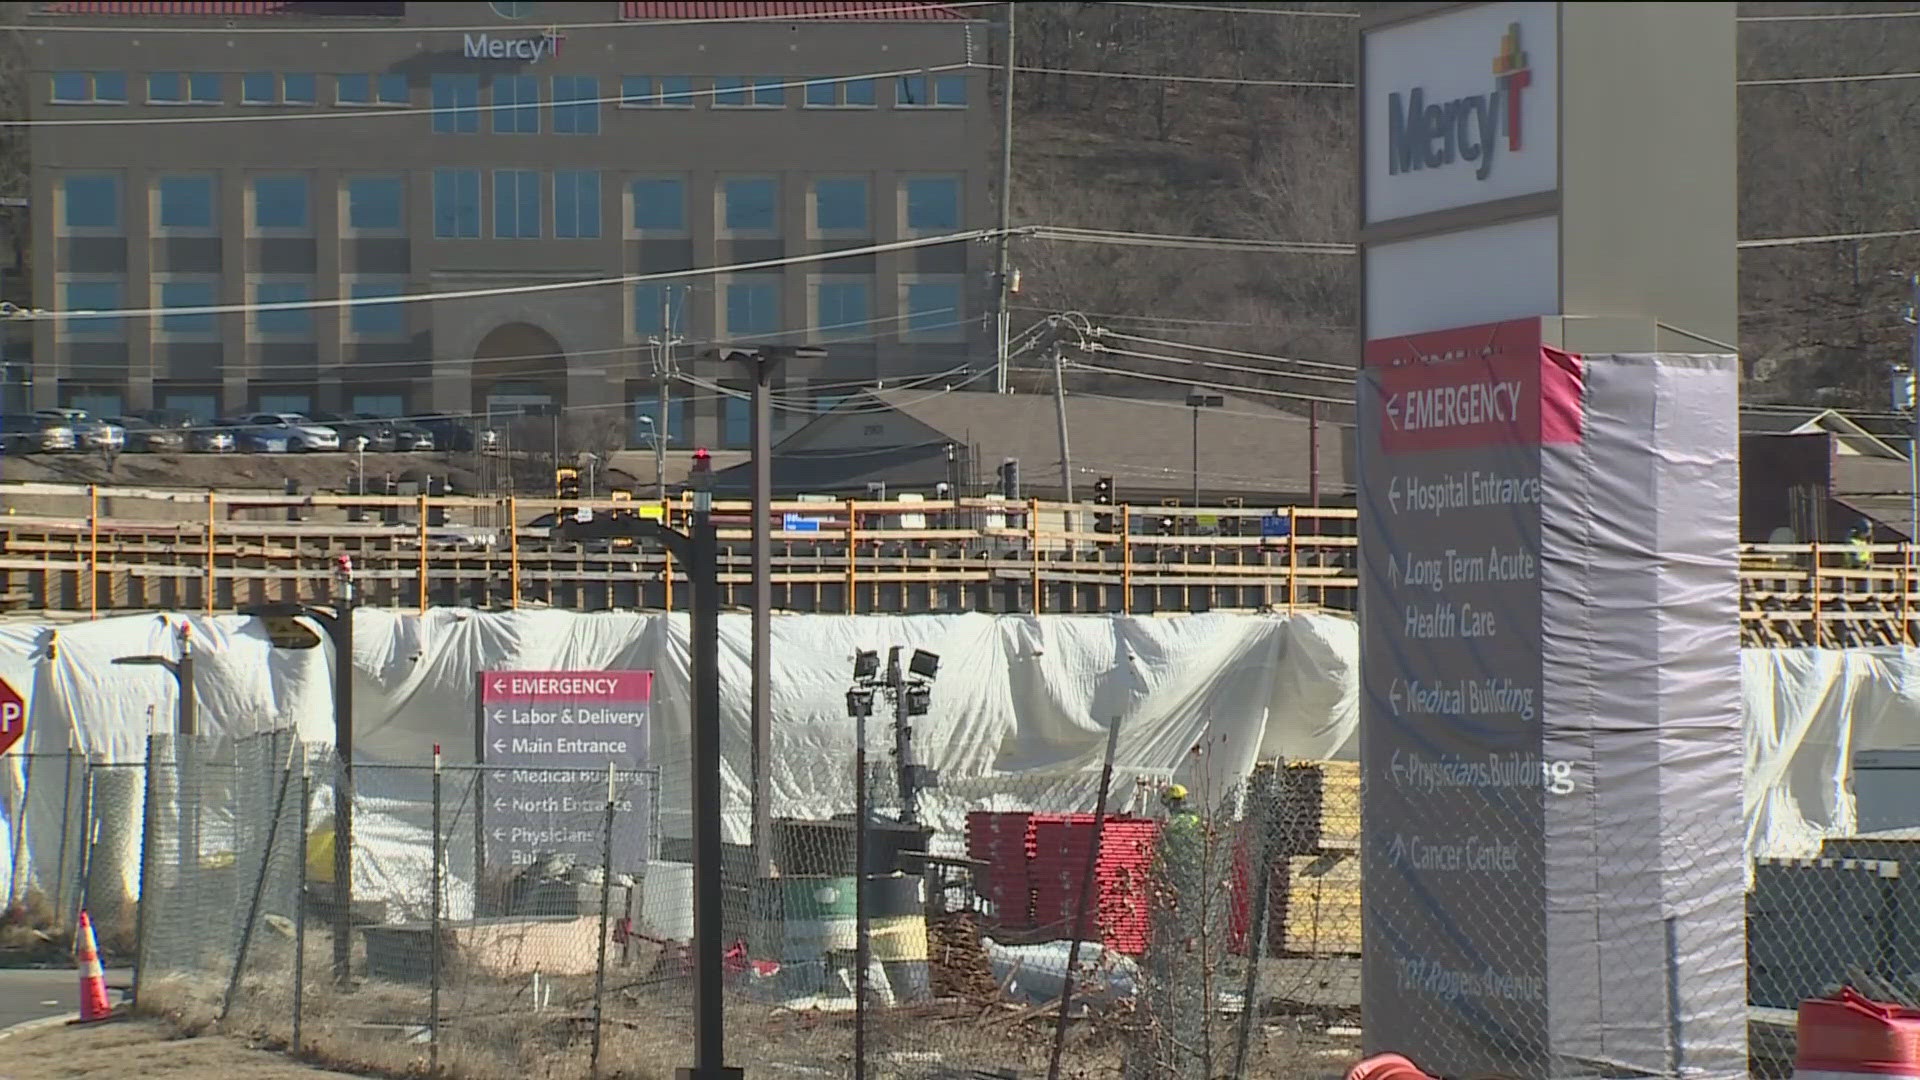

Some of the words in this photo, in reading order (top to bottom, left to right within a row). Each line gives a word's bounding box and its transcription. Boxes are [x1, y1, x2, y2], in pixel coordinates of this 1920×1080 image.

[463, 32, 545, 64] Mercy
[1389, 86, 1499, 181] Mercy
[1404, 380, 1522, 430] EMERGENCY
[1406, 472, 1469, 517] Hospital
[1472, 471, 1541, 506] Entrance
[1405, 552, 1443, 592] Long
[1445, 549, 1485, 584] Term
[1488, 546, 1536, 581] Acute
[1405, 603, 1455, 639] Health
[1461, 603, 1497, 638] Care
[511, 678, 619, 695] EMERGENCY
[1404, 678, 1466, 714] Medical
[1469, 678, 1535, 720] Building
[511, 708, 557, 725] Labor
[561, 708, 575, 725] &
[578, 708, 645, 728] Delivery
[511, 737, 554, 754] Main
[557, 737, 628, 754] Entrance
[512, 769, 576, 783] Medical
[1408, 753, 1490, 795] Physicians
[1490, 753, 1575, 795] Building
[512, 796, 559, 812] North
[563, 797, 633, 812] Entrace
[512, 826, 595, 846] Physicians
[1411, 834, 1464, 871] Cancer
